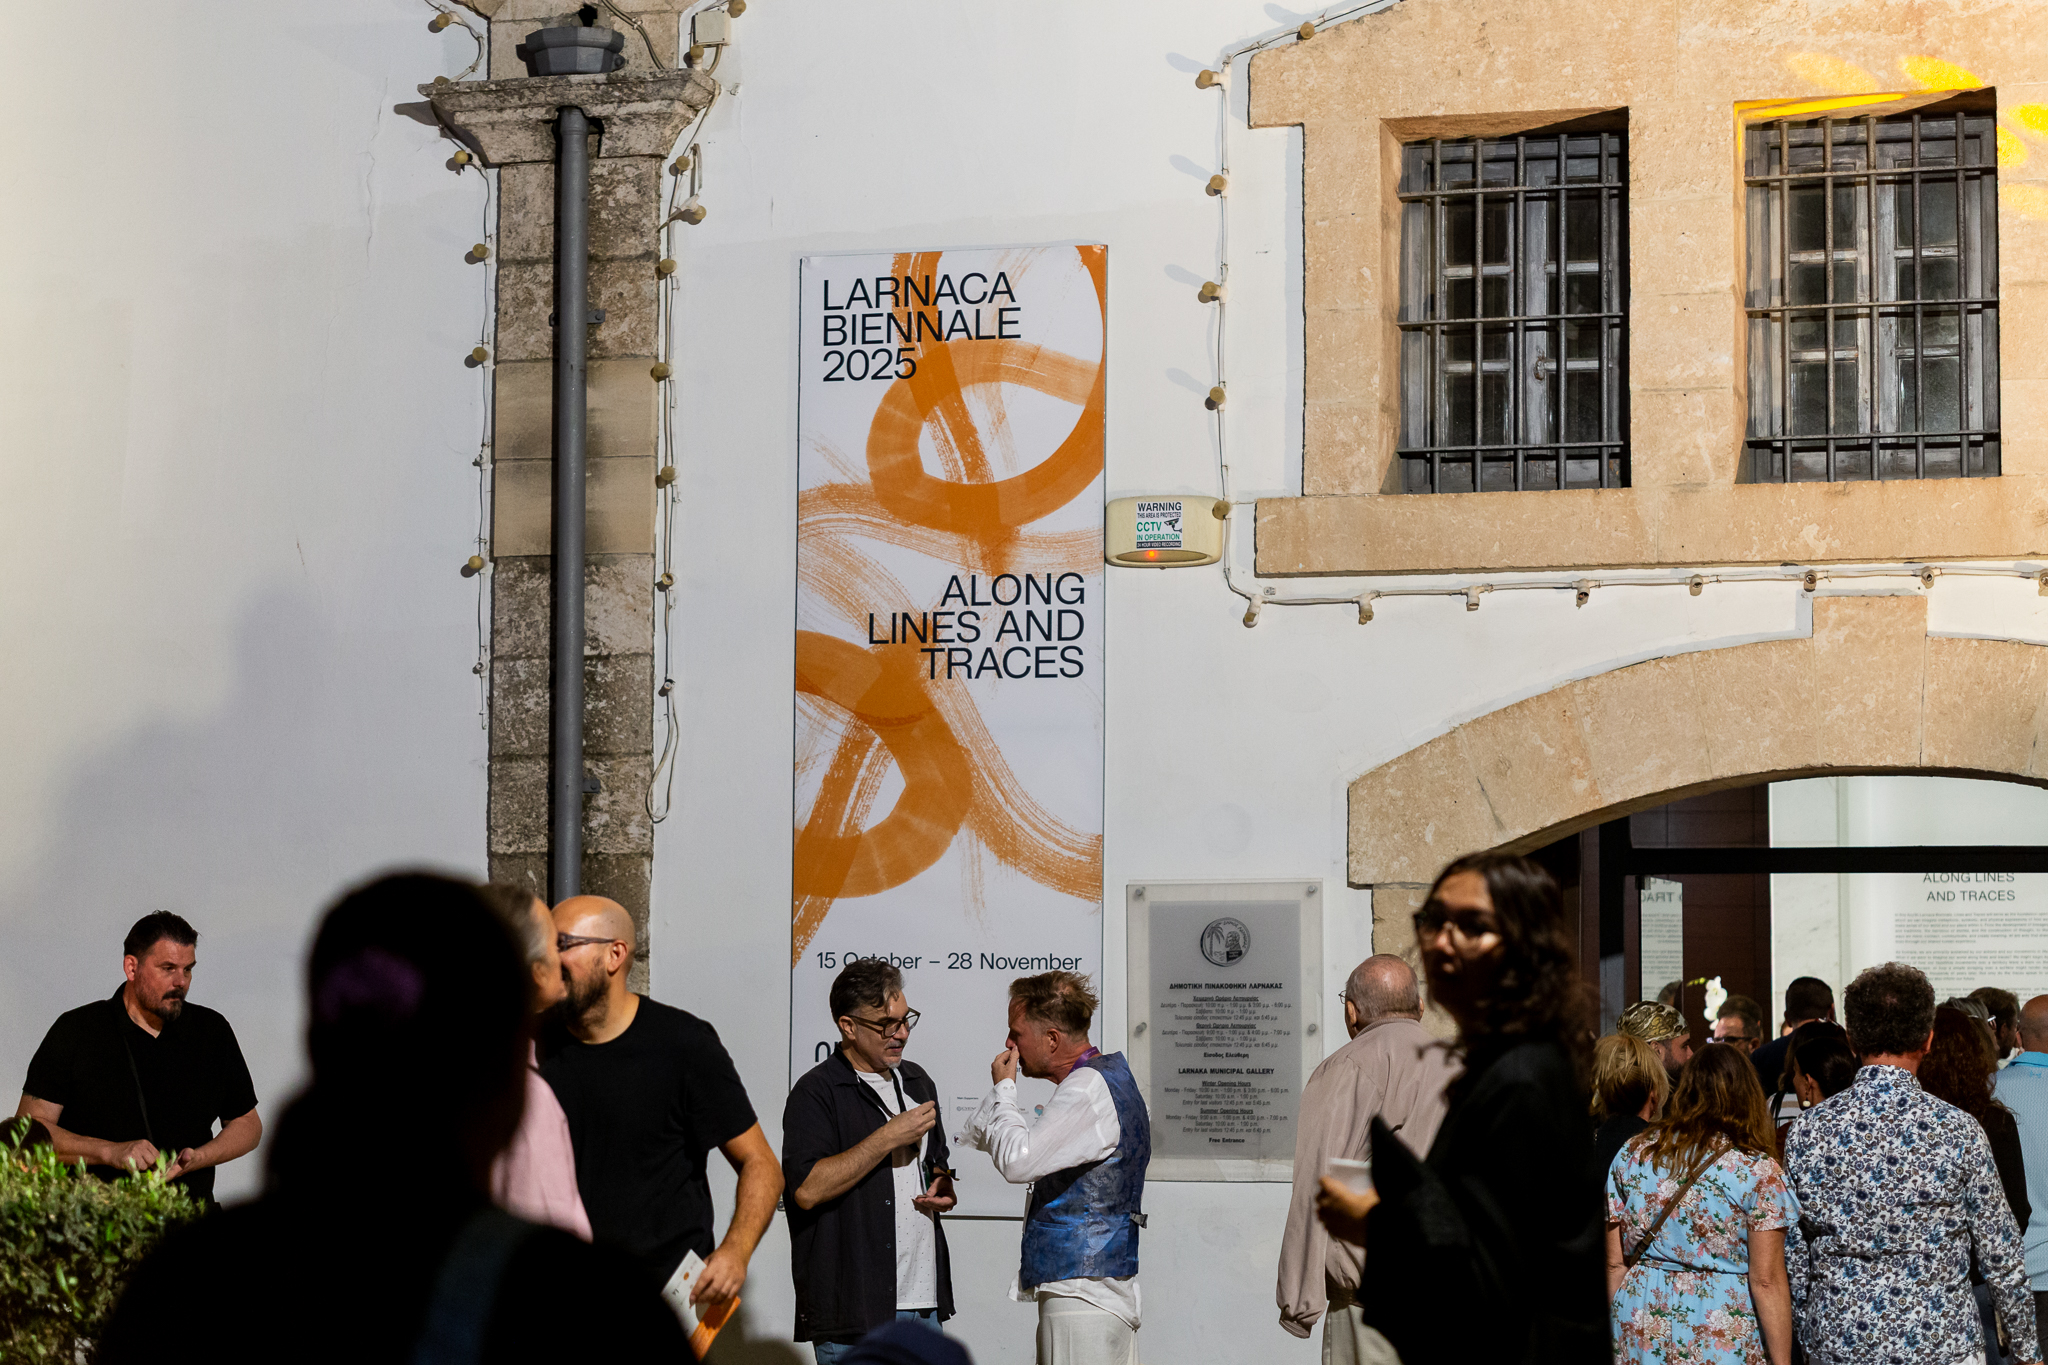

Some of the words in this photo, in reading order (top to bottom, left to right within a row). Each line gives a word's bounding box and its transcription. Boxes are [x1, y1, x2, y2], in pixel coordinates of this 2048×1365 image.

[823, 271, 1016, 310] LARNACA
[823, 307, 1022, 346] BIENNALE
[823, 347, 918, 382] 2025
[1138, 502, 1182, 512] WARNING
[1136, 522, 1162, 532] CCTV
[940, 572, 1085, 607] ALONG
[869, 610, 981, 644] LINES
[995, 609, 1084, 642] AND
[921, 645, 1084, 680] TRACES
[1922, 873, 1970, 883] ALONG
[1976, 873, 2015, 882] LINES
[1926, 890, 1956, 902] AND
[1960, 890, 2015, 901] TRACES
[816, 952, 836, 968] 15
[947, 952, 972, 969] 28
[980, 953, 1082, 970] November
